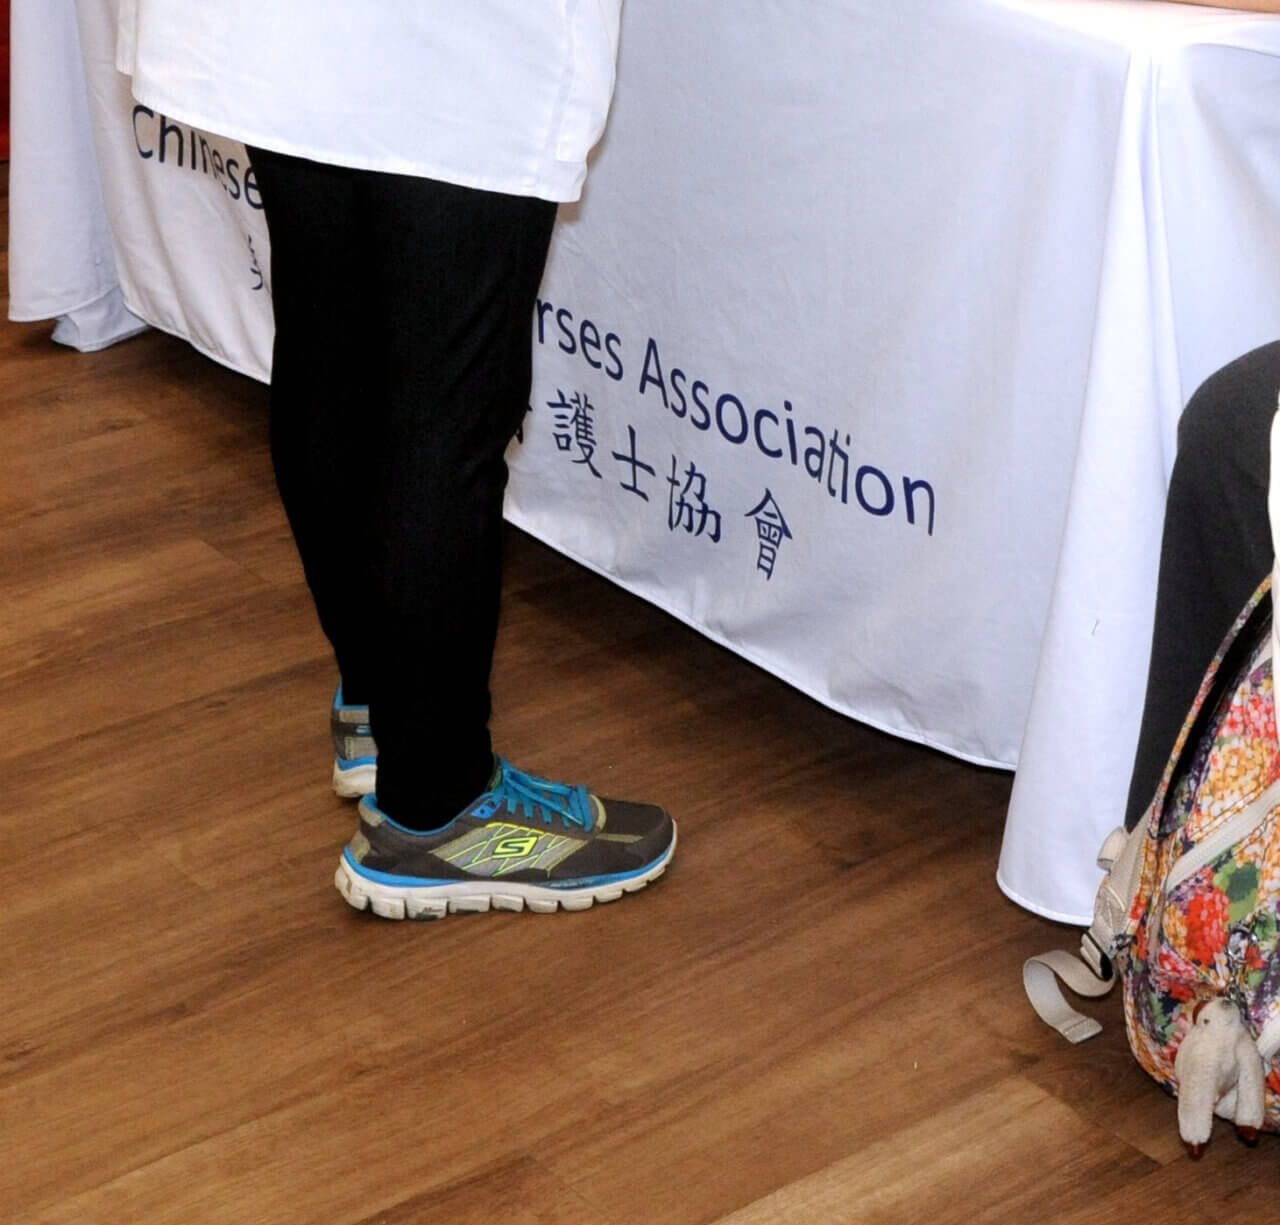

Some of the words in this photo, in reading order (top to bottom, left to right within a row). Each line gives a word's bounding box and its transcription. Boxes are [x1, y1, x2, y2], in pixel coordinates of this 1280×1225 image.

[546, 387, 793, 581] 護士協會
[638, 336, 936, 537] Association
